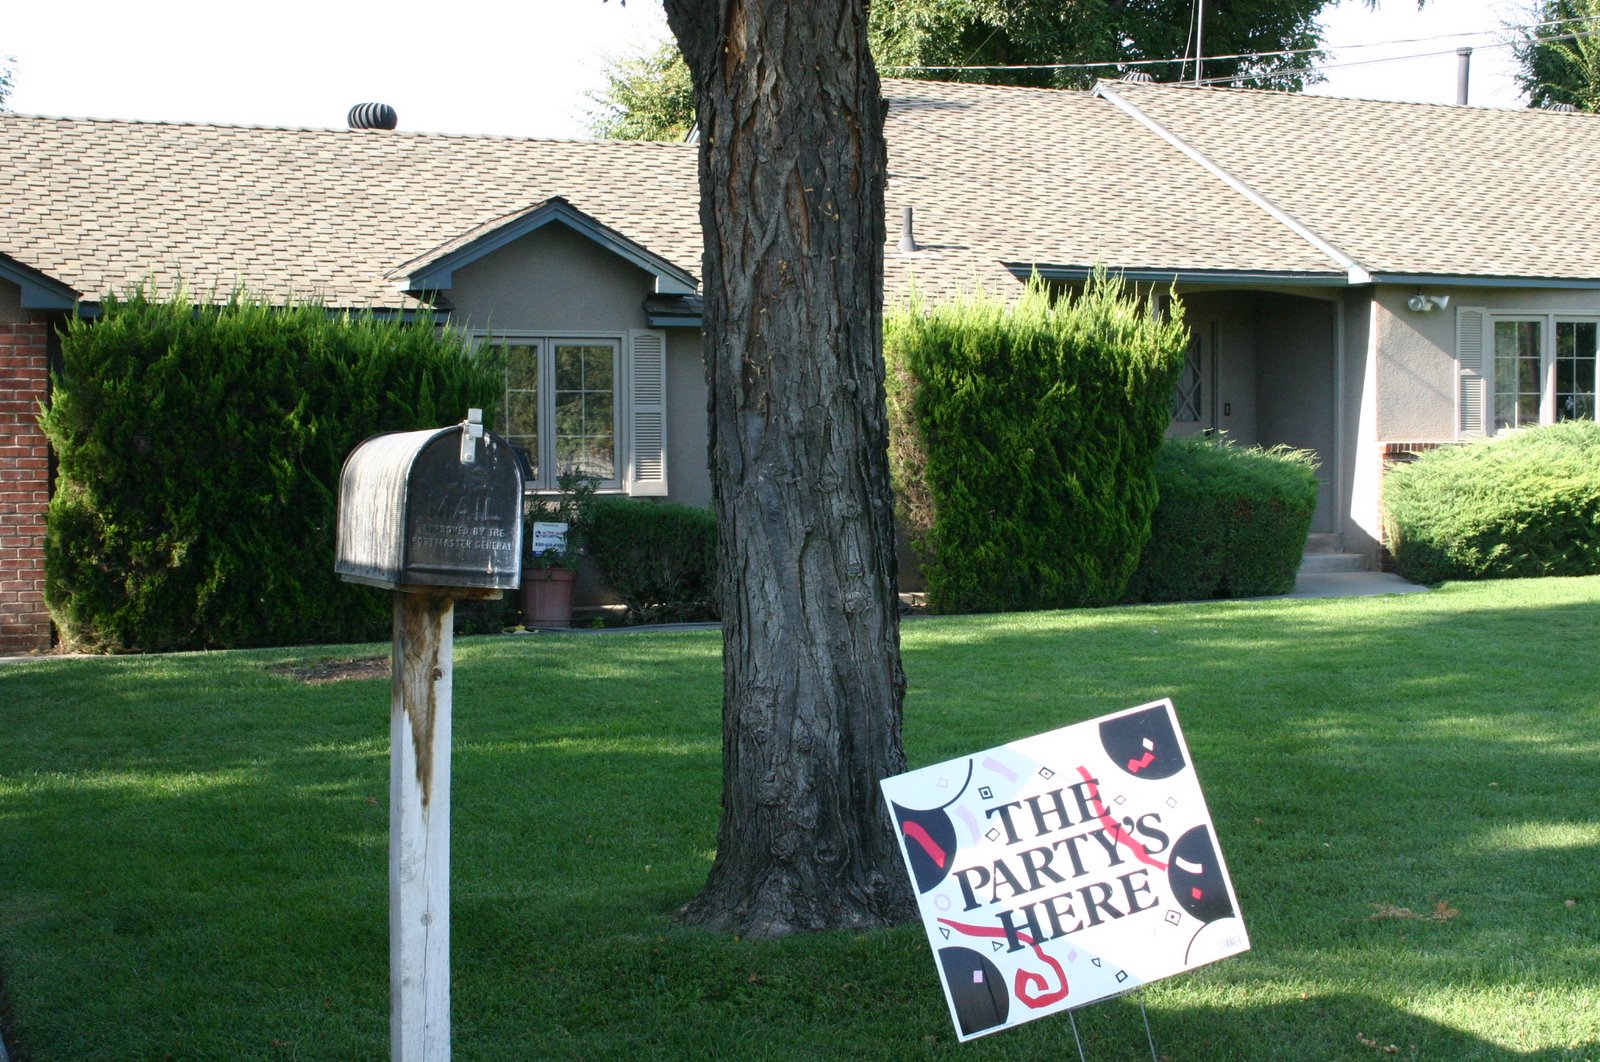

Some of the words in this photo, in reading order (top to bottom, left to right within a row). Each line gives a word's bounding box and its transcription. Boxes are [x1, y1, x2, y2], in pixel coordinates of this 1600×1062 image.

[472, 526, 486, 536] BY
[474, 540, 512, 551] GENERAL
[985, 778, 1111, 846] THE
[953, 812, 1170, 912] PARTY'S
[995, 868, 1159, 954] HERE
